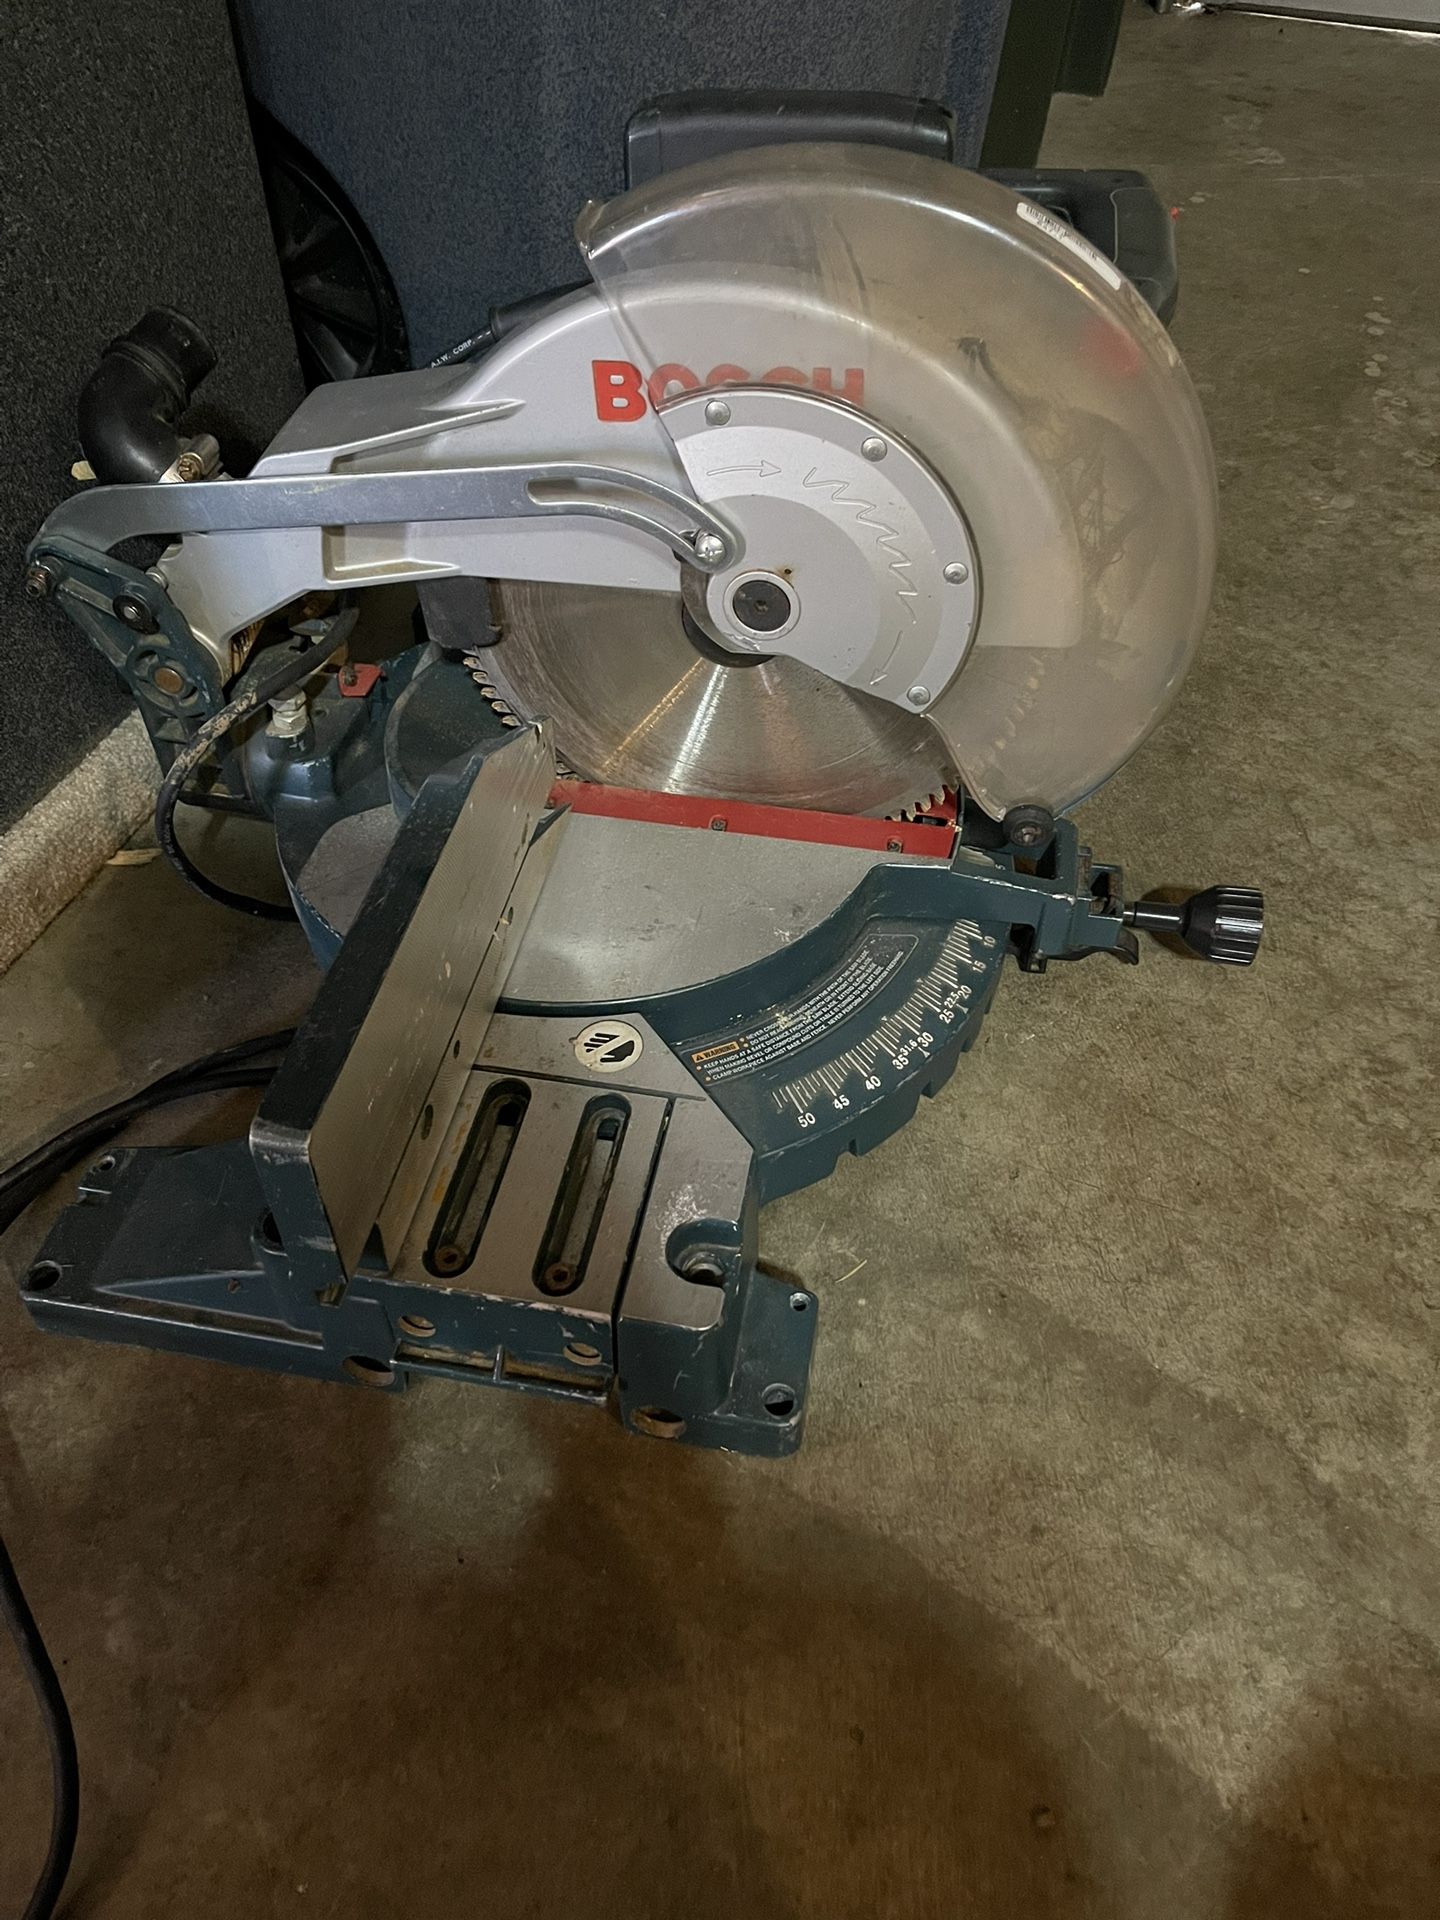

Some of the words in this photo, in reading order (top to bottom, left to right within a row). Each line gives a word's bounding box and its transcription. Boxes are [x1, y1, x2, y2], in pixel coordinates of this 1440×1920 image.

[453, 339, 475, 354] CORP.
[983, 936, 996, 948] 10
[972, 960, 986, 973] 15
[944, 991, 959, 1009] 22.5
[958, 985, 972, 999] 20
[939, 1008, 955, 1024] 25
[746, 1029, 764, 1040] NEVER
[750, 1038, 760, 1046] DO
[759, 1033, 770, 1042] NOT
[918, 1031, 934, 1048] 30
[703, 1060, 719, 1069] KEEP
[718, 1053, 740, 1064] HANDS
[751, 1042, 766, 1052] SAFE
[765, 1030, 790, 1046] DISTANCE
[789, 1021, 805, 1034] FROM
[703, 1043, 736, 1058] WARNING
[707, 1065, 725, 1076] WHEN
[724, 1058, 747, 1070] MAKING
[746, 1050, 765, 1061] BEVEL
[764, 1046, 773, 1054] OR
[772, 1032, 802, 1050] COMPOUND
[800, 1024, 815, 1035] CUTS
[900, 1038, 918, 1057] 31.6
[712, 1069, 733, 1081] CLAMP
[732, 1056, 765, 1074] WORKPIECE
[764, 1047, 787, 1062] AGAINST
[786, 1039, 802, 1051] BASE
[800, 1033, 812, 1043] AND
[892, 1054, 909, 1070] 35
[865, 1075, 881, 1090] 40
[833, 1094, 850, 1110] 45
[797, 1112, 816, 1128] 50
